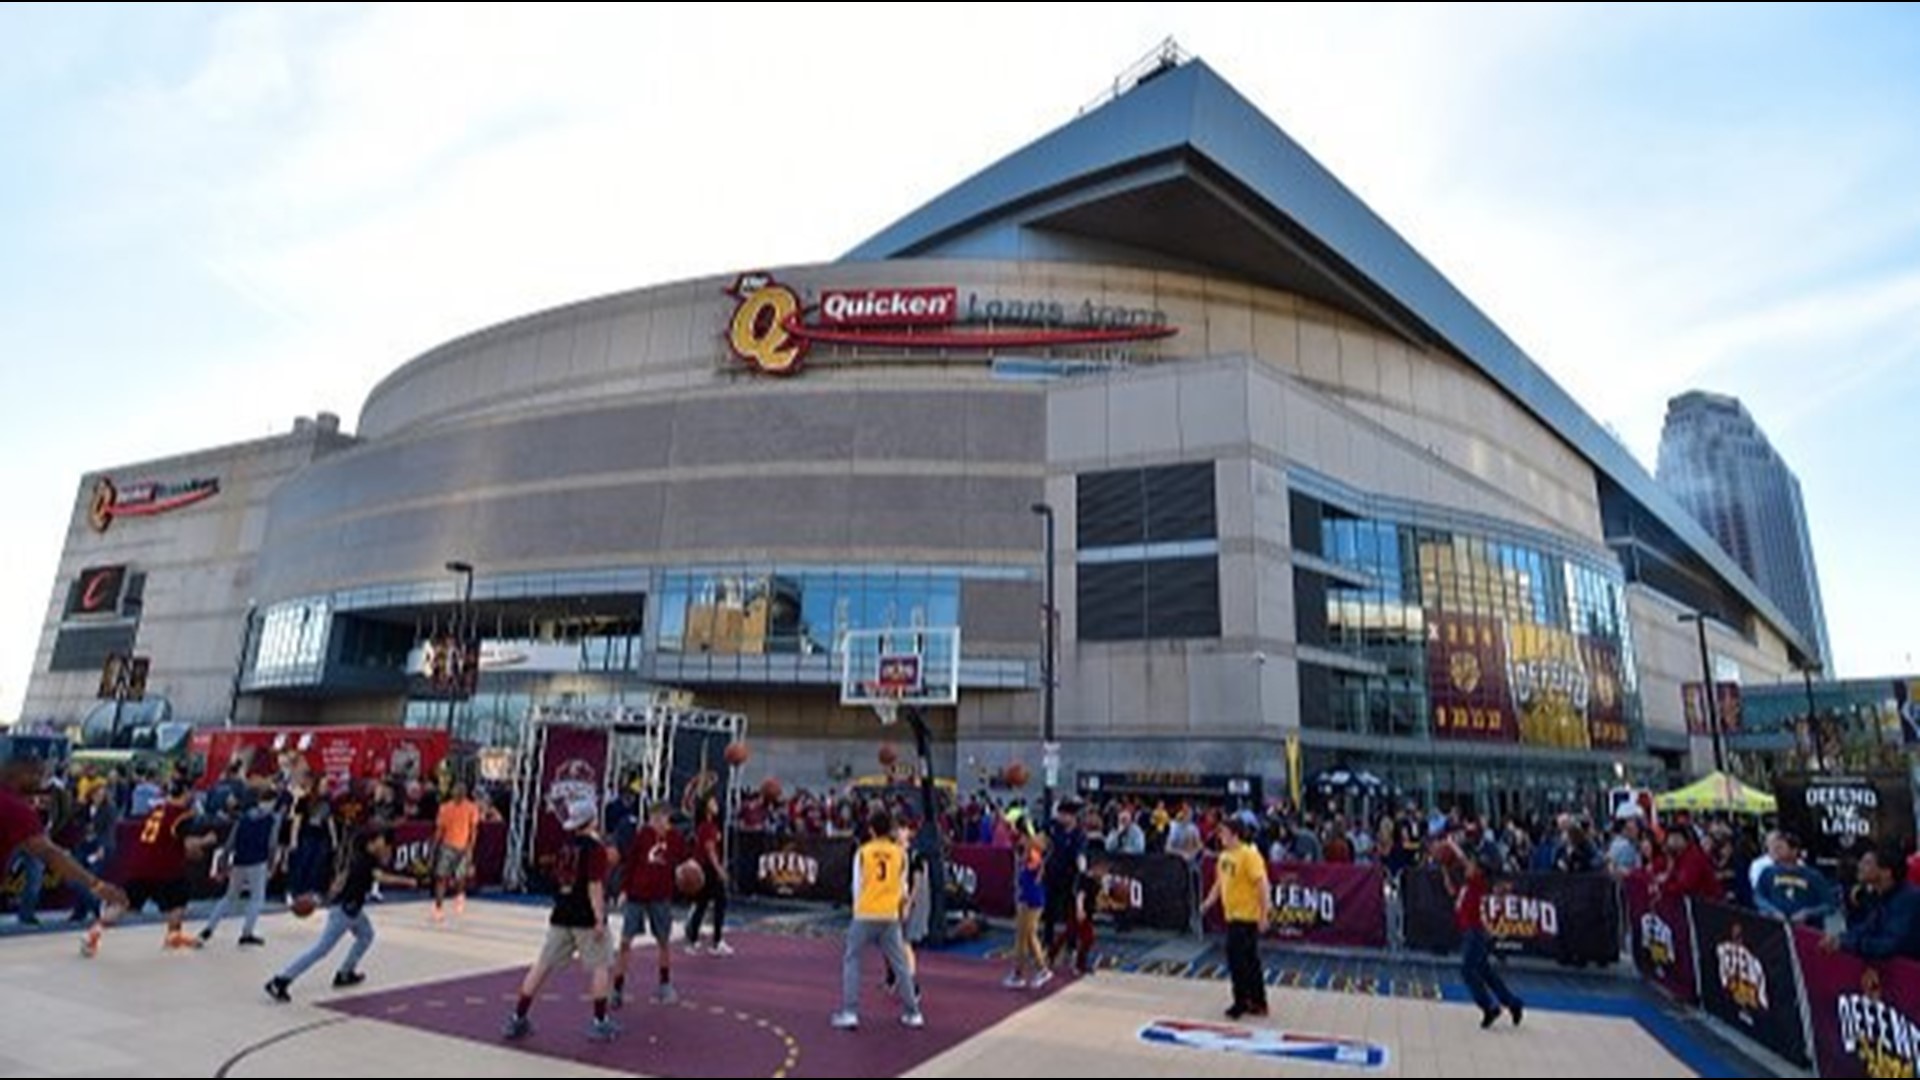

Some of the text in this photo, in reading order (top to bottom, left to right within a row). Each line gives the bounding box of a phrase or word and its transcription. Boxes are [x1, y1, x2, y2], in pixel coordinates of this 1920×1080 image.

[823, 292, 951, 321] Quicken
[732, 287, 800, 370] Q
[1805, 787, 1877, 807] DEFEND
[1822, 818, 1870, 836] LAND
